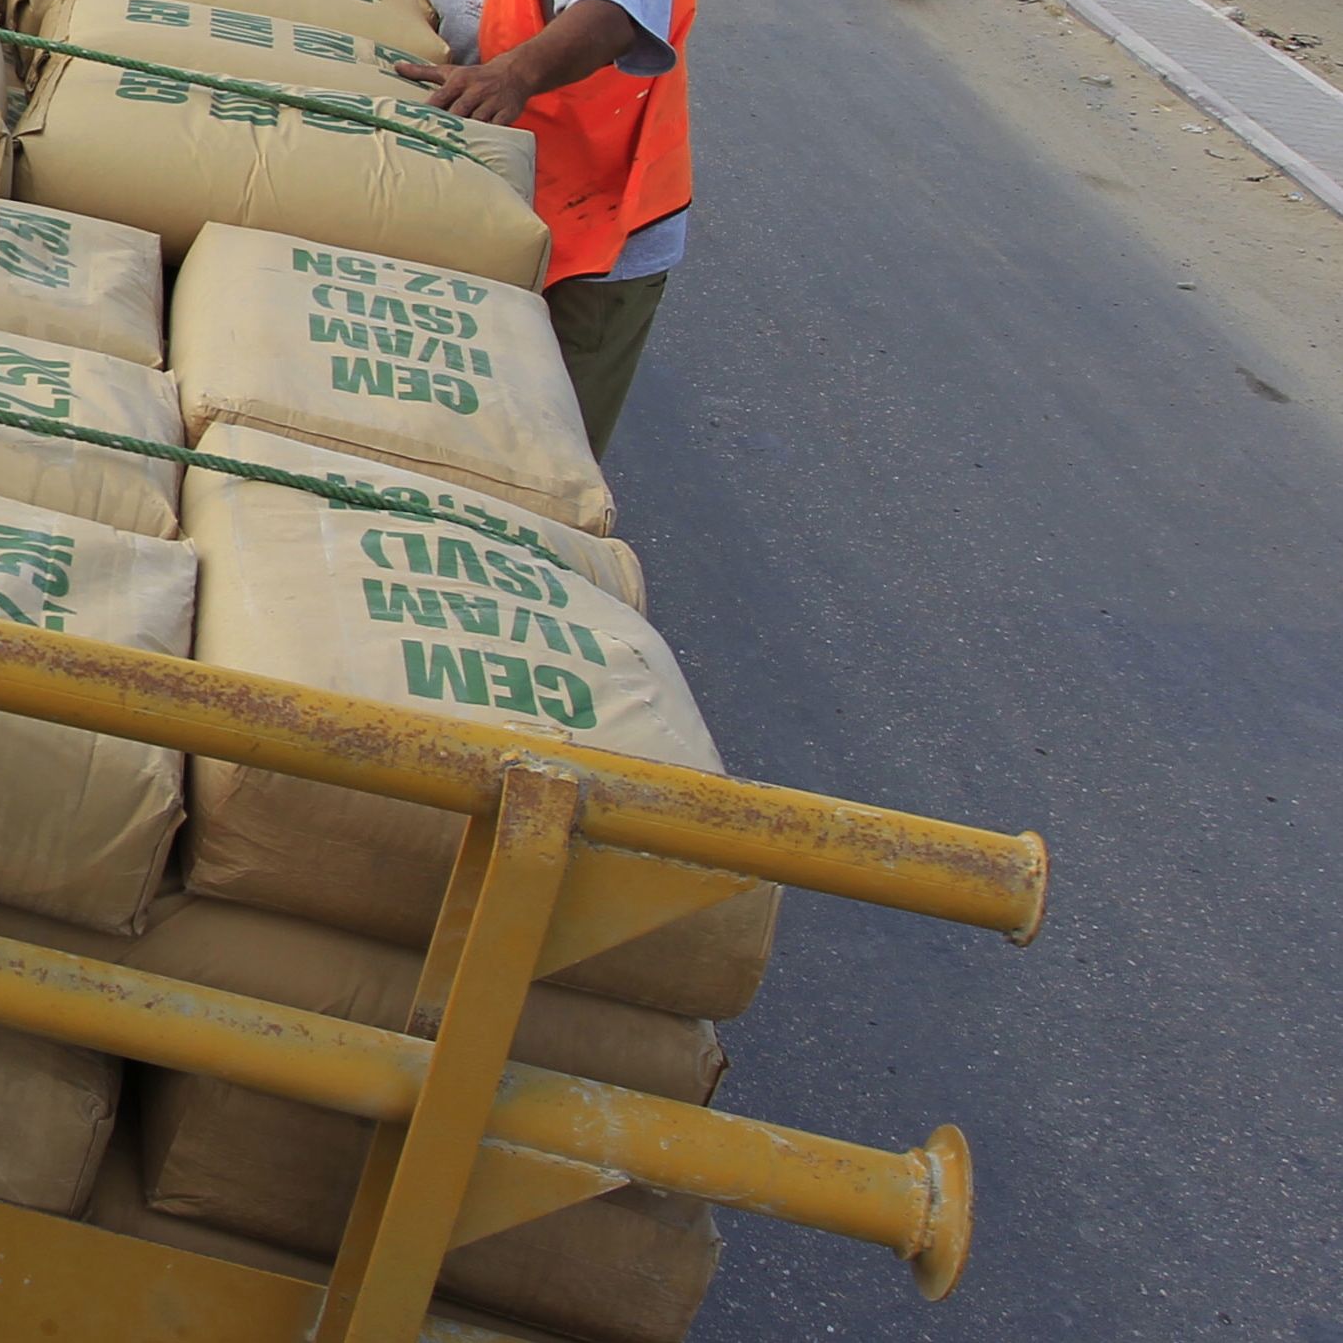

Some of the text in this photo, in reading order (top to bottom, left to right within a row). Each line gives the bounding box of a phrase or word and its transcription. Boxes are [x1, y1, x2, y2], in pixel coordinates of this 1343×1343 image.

[115, 70, 190, 104] CE
[292, 247, 489, 306] 42,5N
[311, 283, 479, 340] (SVL)
[308, 312, 492, 379] II/AM
[331, 356, 480, 415] CEM
[360, 528, 569, 609] (SVL)
[361, 578, 607, 667] II/AM
[401, 639, 598, 730] CEM
